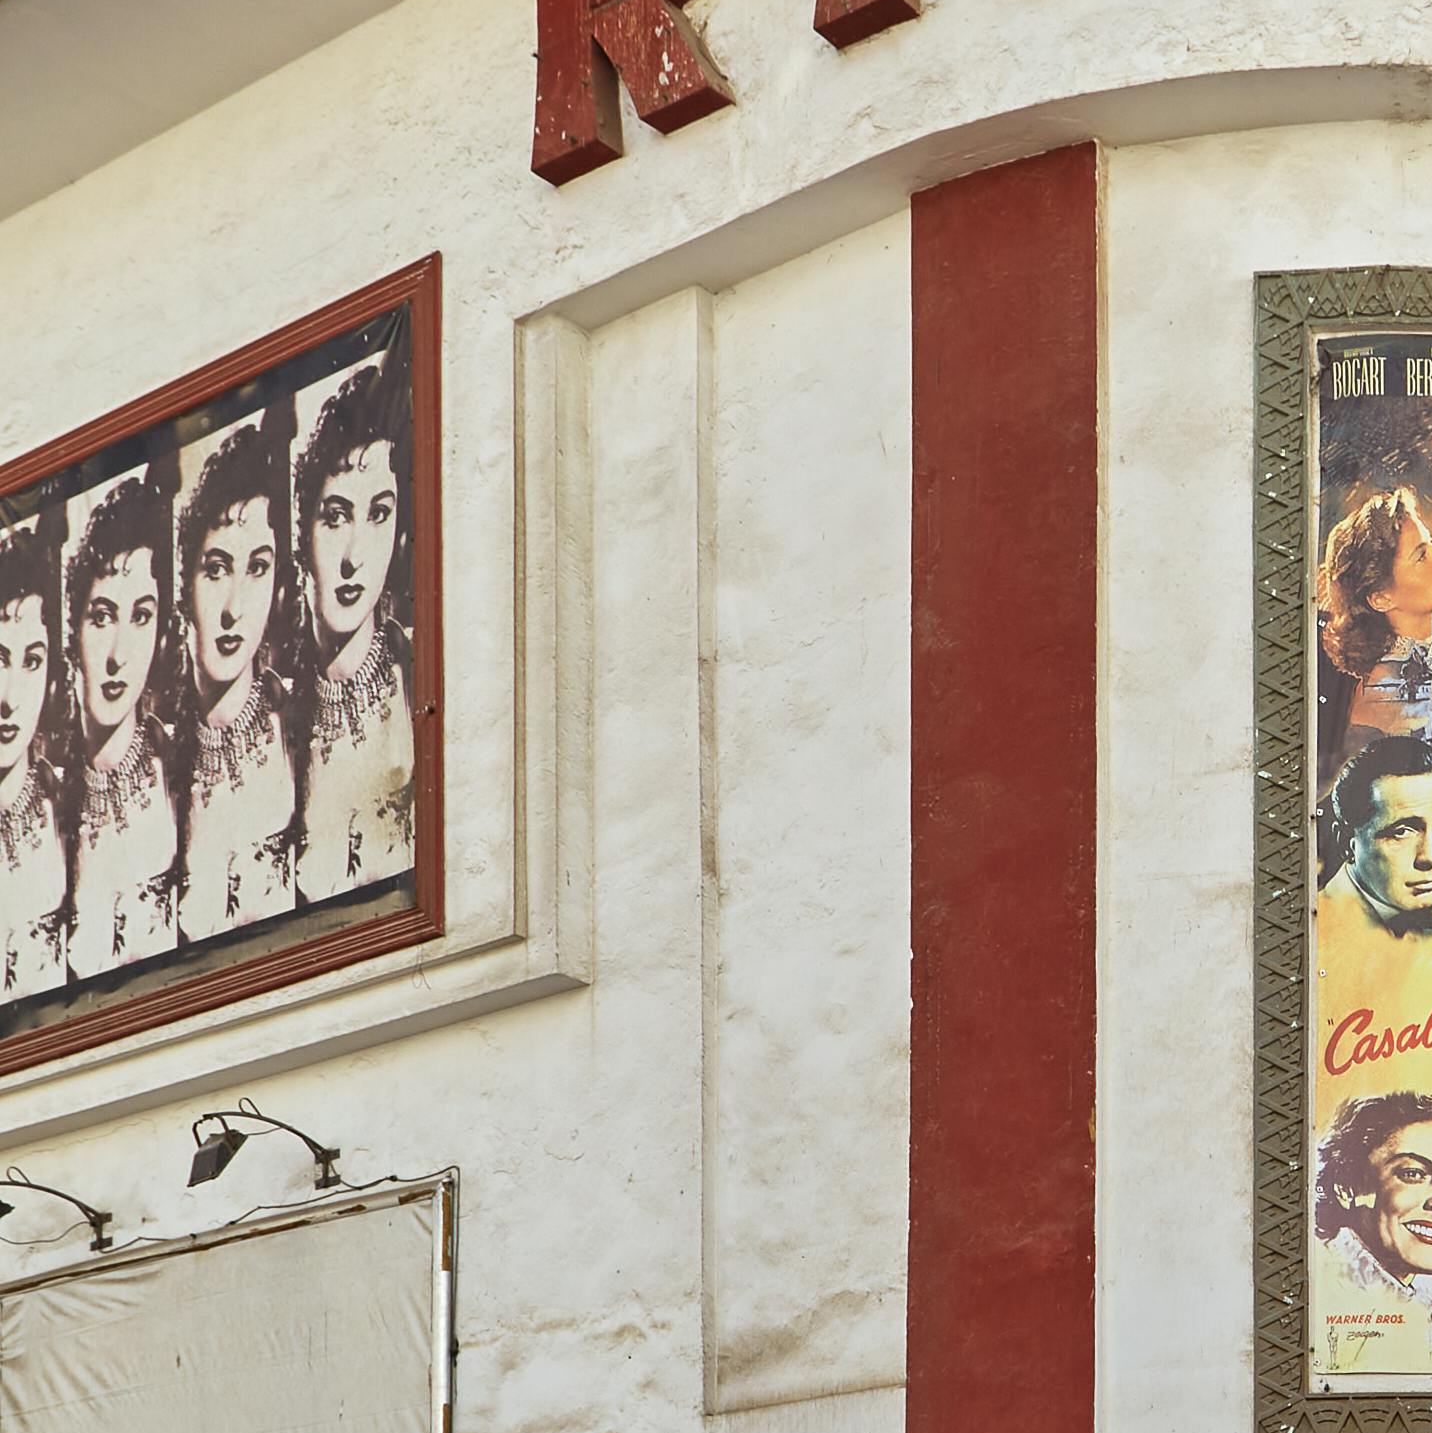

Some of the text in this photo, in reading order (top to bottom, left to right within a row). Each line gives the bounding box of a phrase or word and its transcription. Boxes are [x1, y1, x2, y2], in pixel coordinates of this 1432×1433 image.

[1332, 357, 1387, 400] BOGART
[1326, 1314, 1406, 1325] WARNER BROS.
